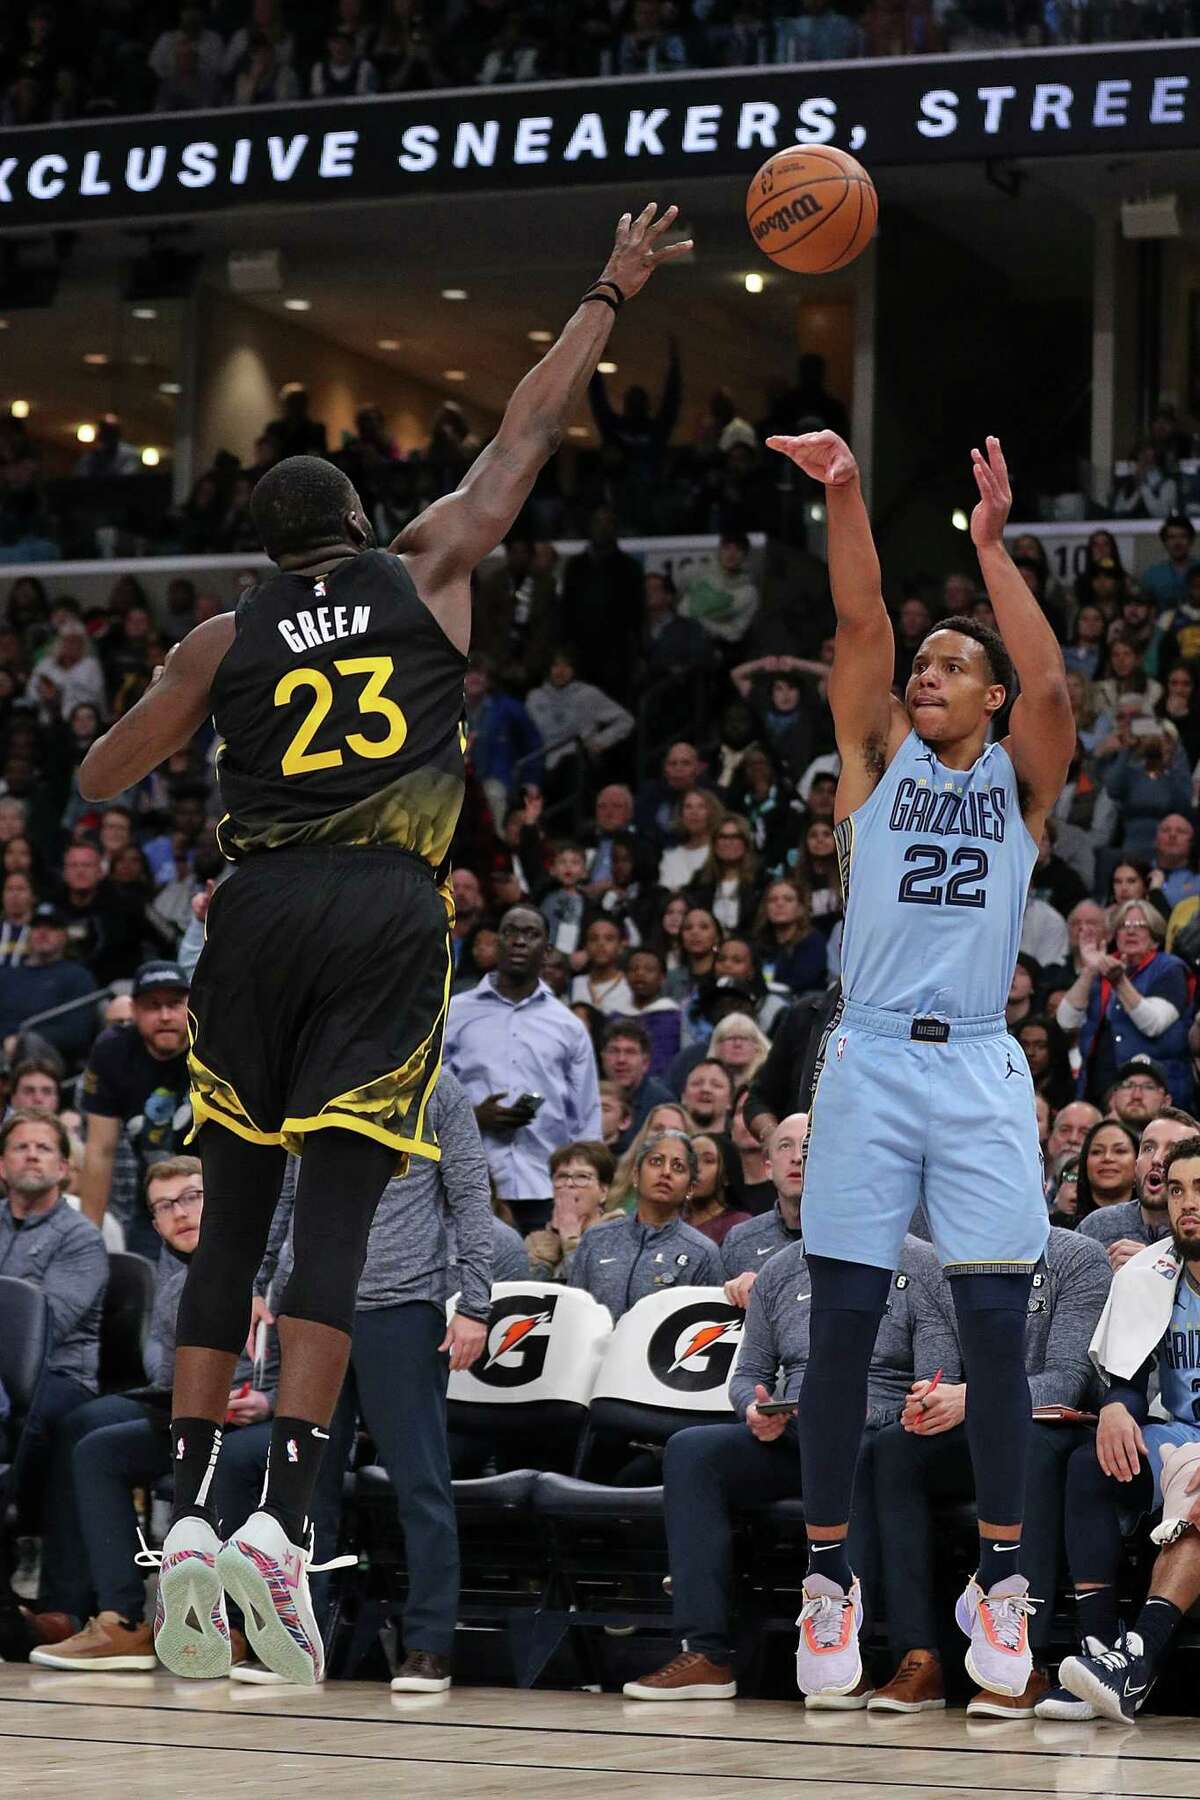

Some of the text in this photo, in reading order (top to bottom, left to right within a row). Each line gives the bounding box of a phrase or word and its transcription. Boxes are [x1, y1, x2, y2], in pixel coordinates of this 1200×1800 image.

[398, 98, 866, 171] SNEAKERS,
[917, 76, 1189, 138] STREE
[753, 194, 823, 240] Wilson
[278, 606, 370, 653] GREEN
[274, 656, 407, 776] 23
[889, 777, 1006, 843] GRIZZLIES
[898, 843, 988, 908] 22
[897, 1275, 907, 1288] 6
[1033, 1274, 1042, 1287] 6
[468, 1295, 559, 1388] G
[648, 1302, 747, 1392] G
